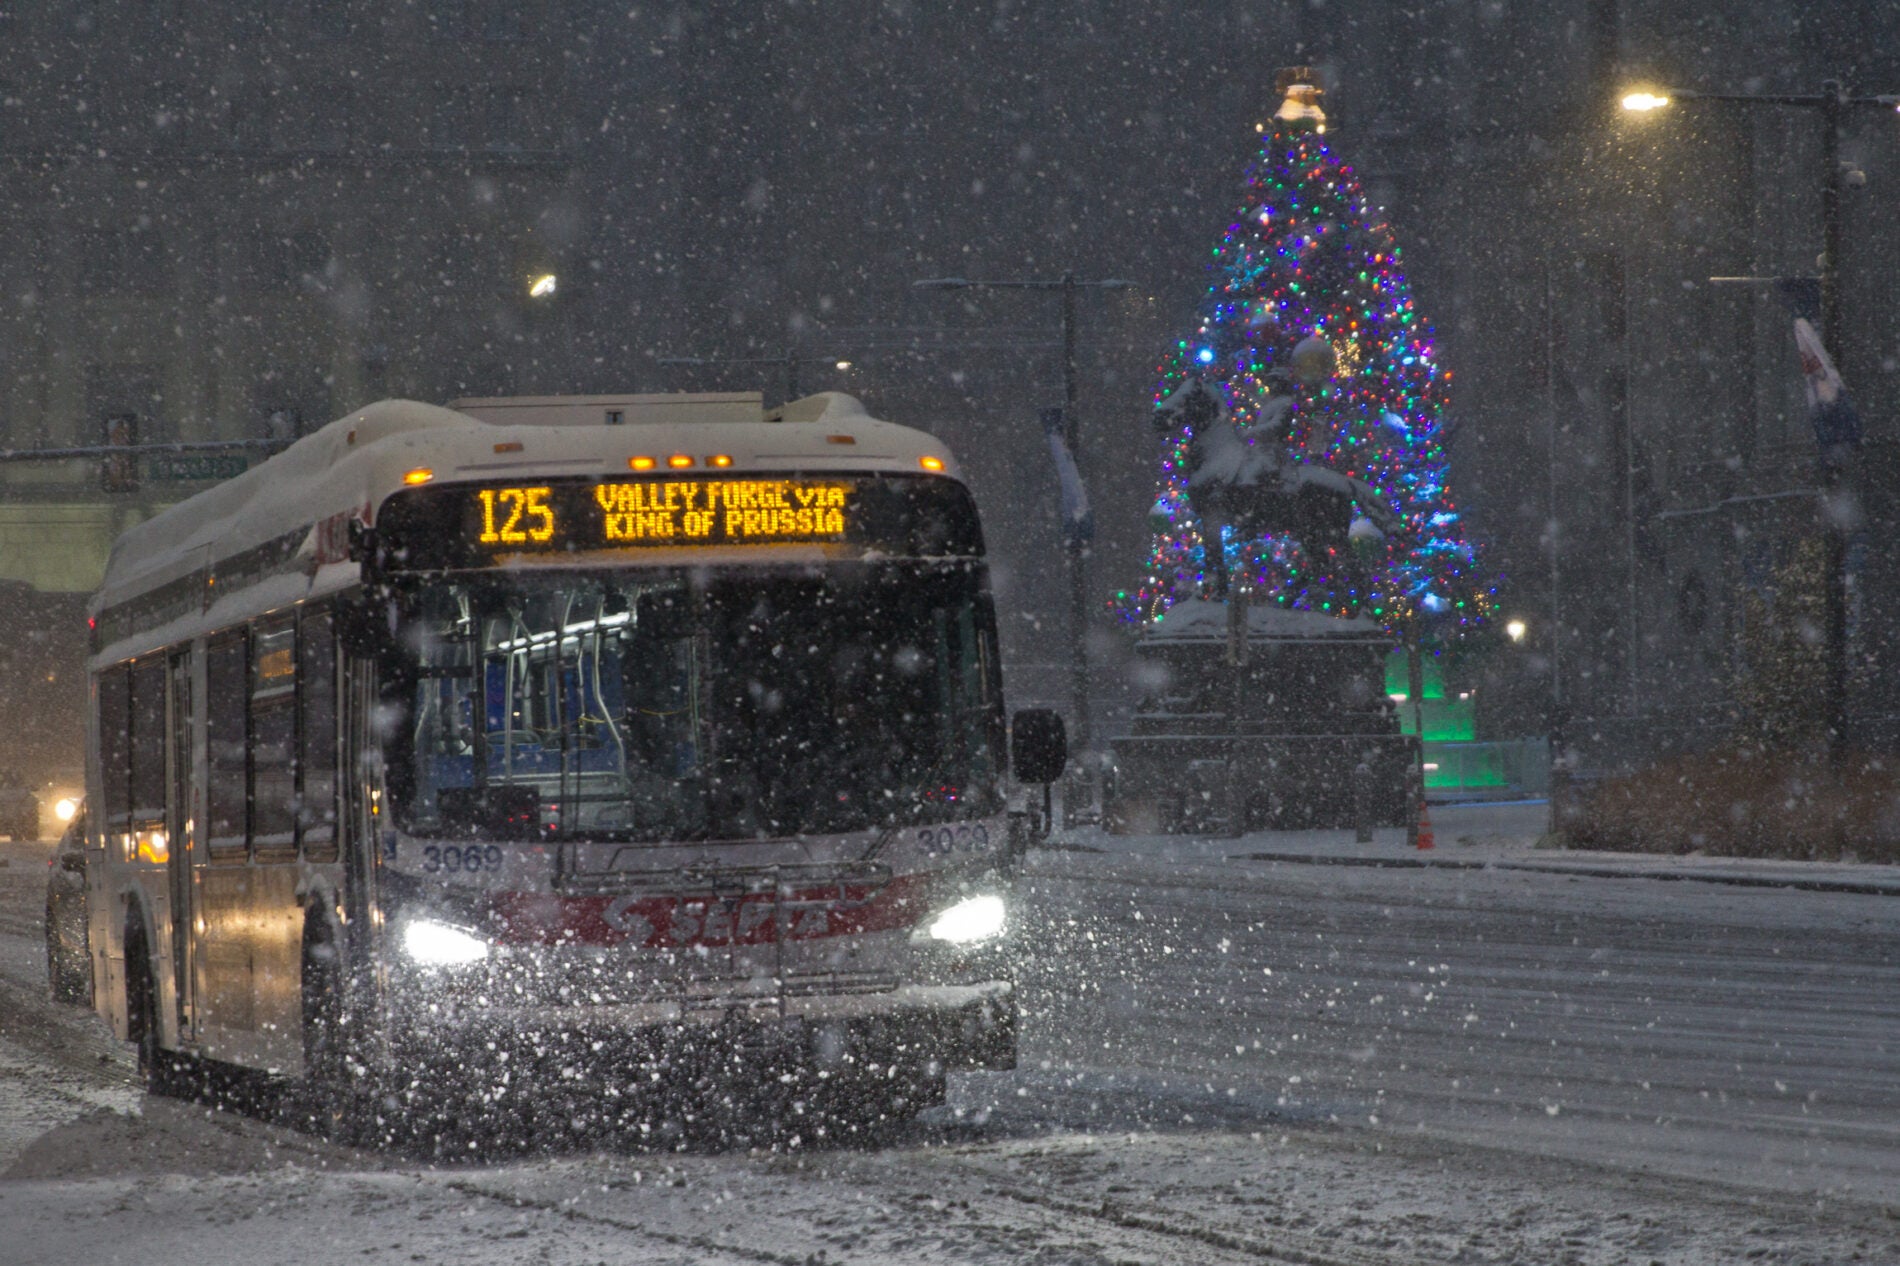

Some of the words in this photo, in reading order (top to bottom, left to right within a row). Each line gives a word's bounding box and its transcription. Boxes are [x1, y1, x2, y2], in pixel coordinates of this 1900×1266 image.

[596, 481, 698, 513] VALLEY
[794, 486, 845, 507] VIA
[479, 486, 555, 543] 125
[605, 511, 674, 540] KING
[683, 510, 716, 537] OF
[725, 507, 844, 536] PRUSSIA
[423, 844, 502, 873] 3069
[669, 898, 829, 942] SEPTA
